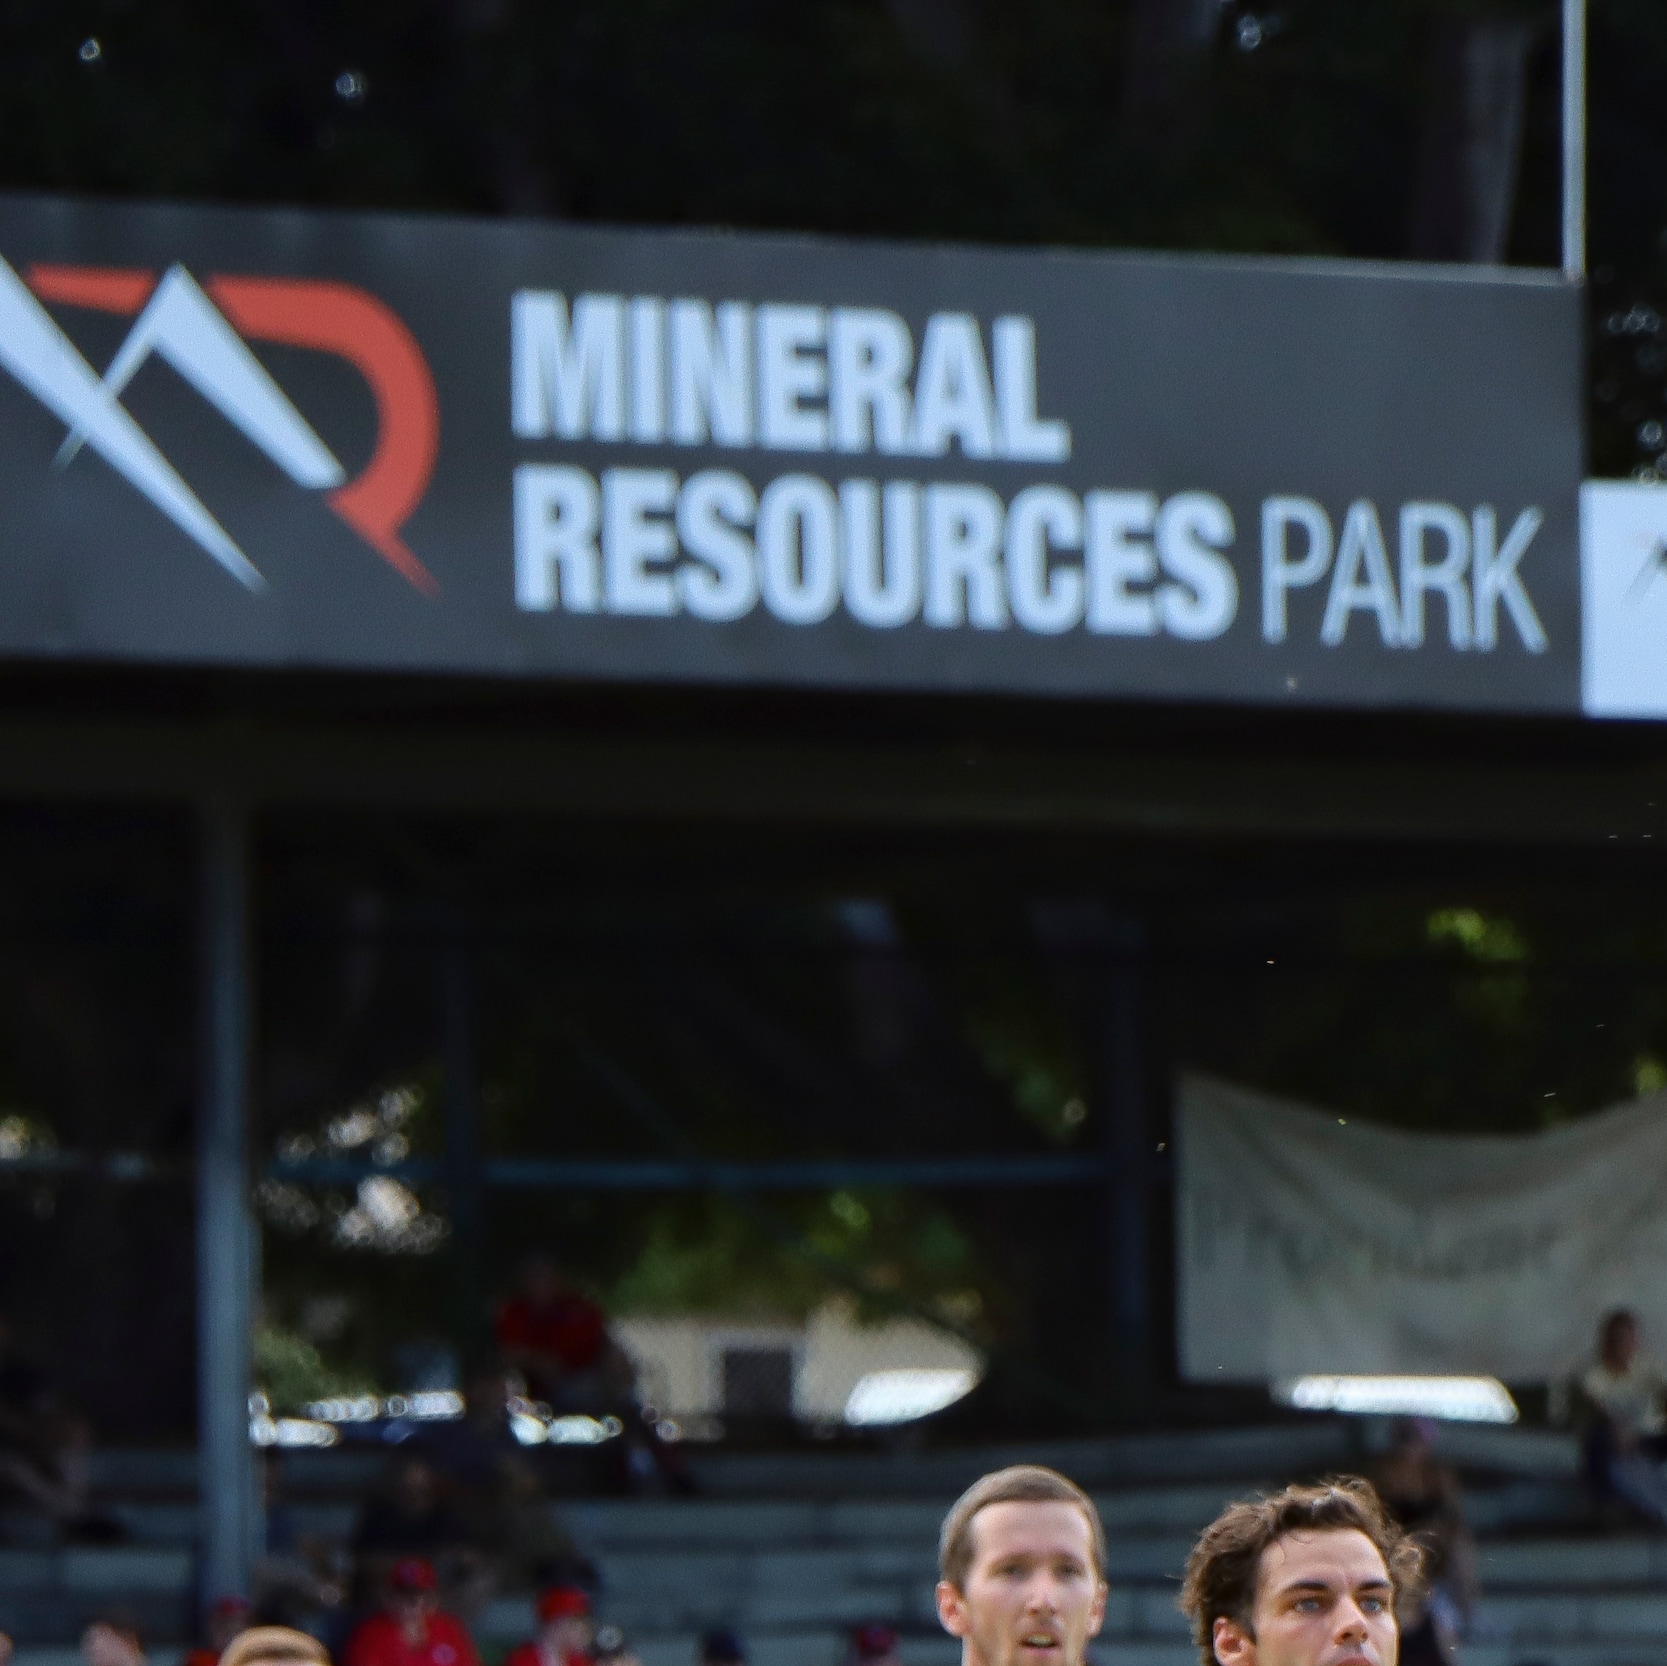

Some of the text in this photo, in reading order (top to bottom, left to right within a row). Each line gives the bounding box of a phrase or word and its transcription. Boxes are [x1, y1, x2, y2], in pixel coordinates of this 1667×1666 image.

[511, 288, 1072, 464] MINERAL
[513, 462, 1549, 654] RESOURCES PARK
